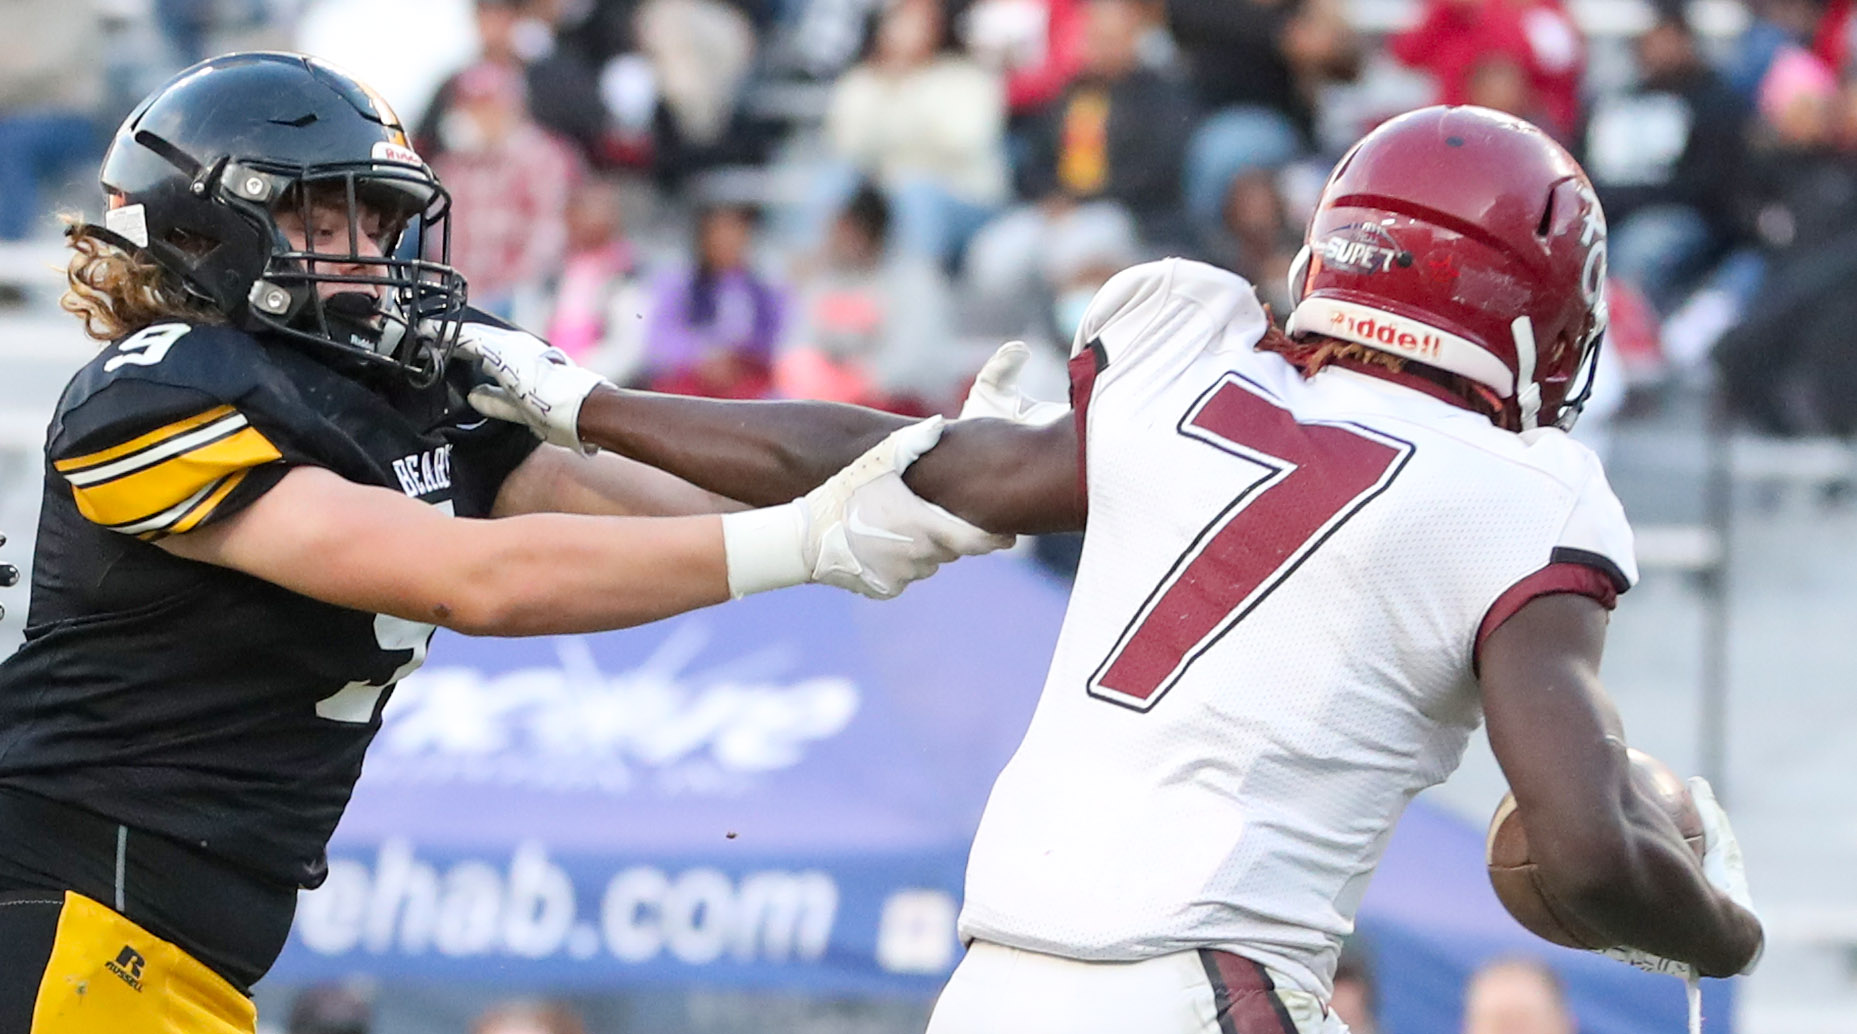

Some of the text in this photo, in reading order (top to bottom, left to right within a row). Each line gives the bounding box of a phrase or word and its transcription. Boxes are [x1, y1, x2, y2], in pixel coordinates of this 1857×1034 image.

[103, 322, 192, 373] 9
[1086, 370, 1416, 714] 7
[105, 961, 142, 993] RUSSELL
[116, 944, 145, 979] R
